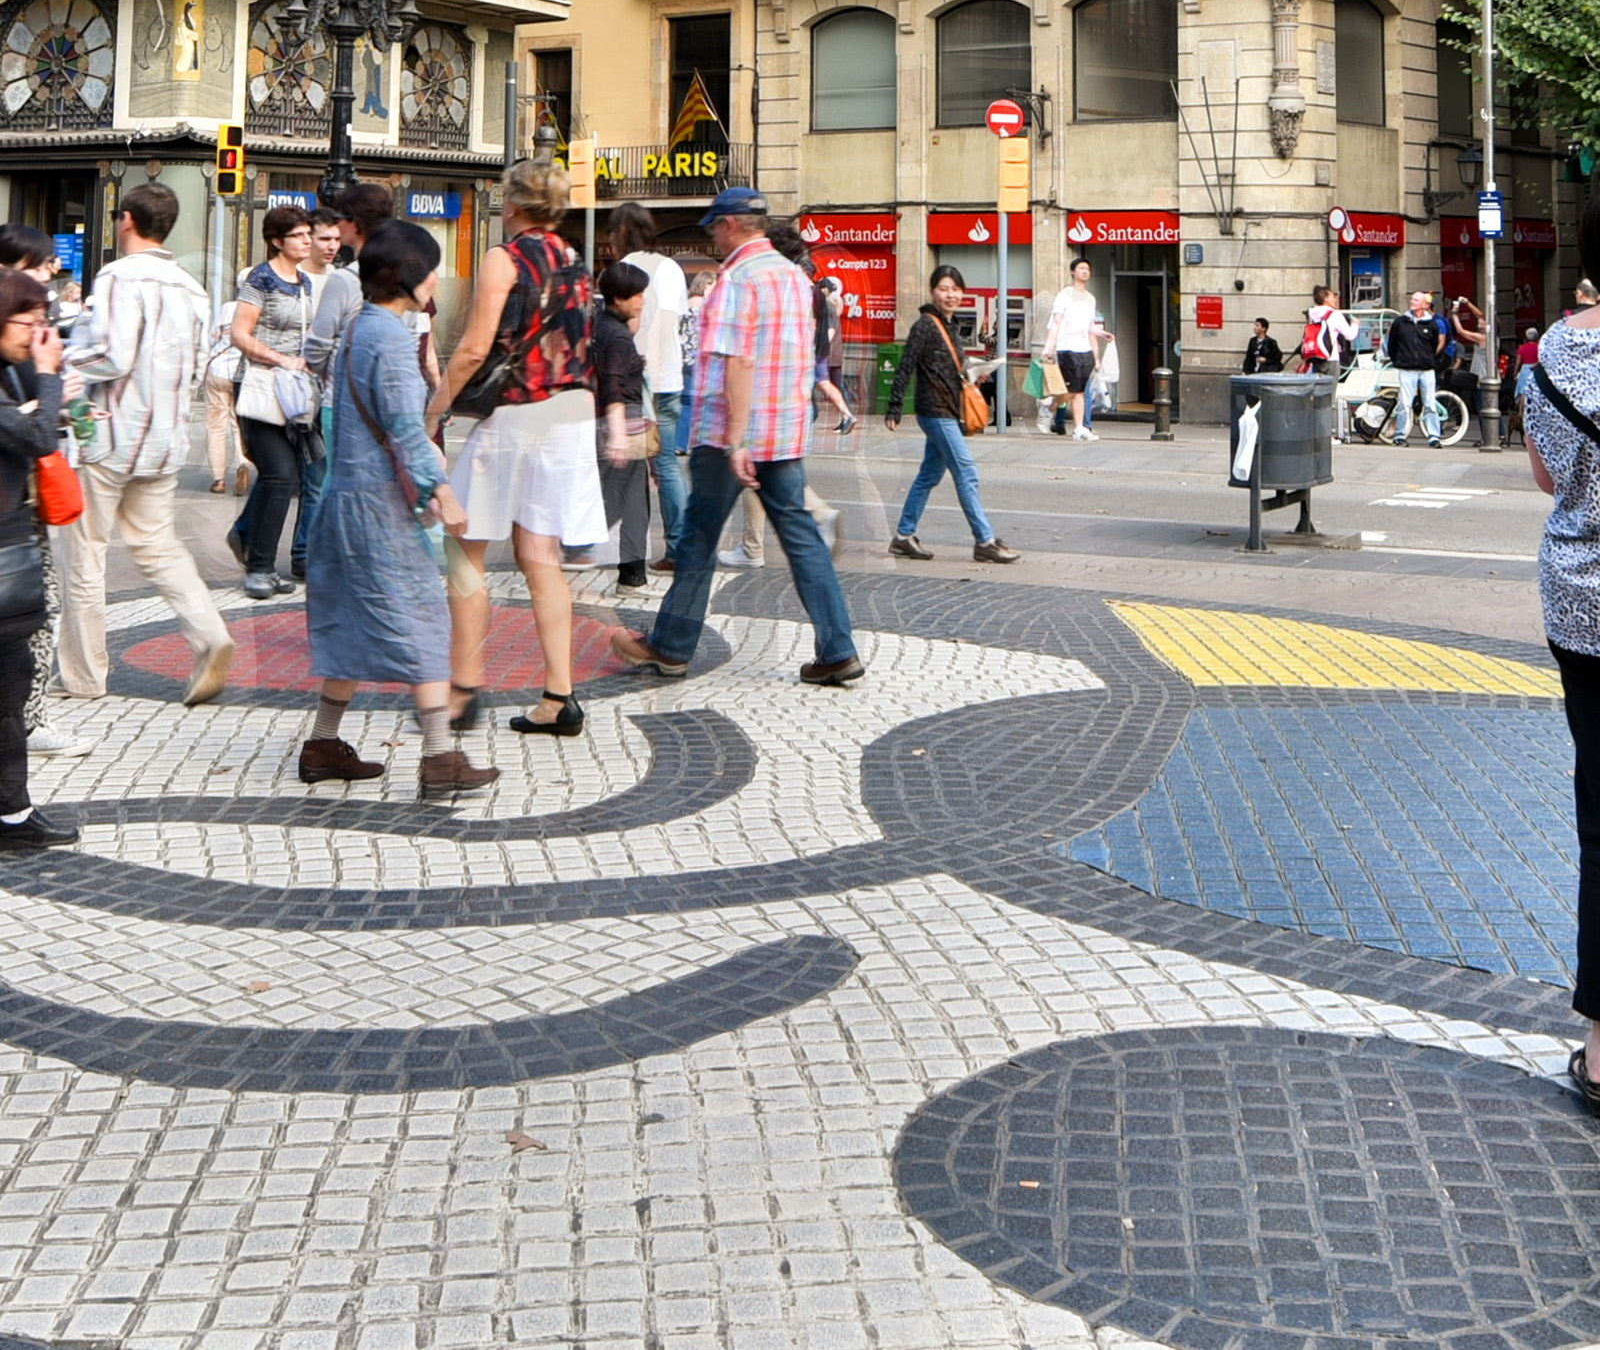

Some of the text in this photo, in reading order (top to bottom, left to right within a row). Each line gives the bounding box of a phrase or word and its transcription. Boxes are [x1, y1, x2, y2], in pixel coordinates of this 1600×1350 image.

[643, 150, 718, 179] PARIS
[411, 194, 445, 215] BBVA
[824, 223, 896, 242] Santander
[1096, 221, 1181, 242] Santander
[1356, 224, 1398, 244] Santander
[1522, 225, 1555, 243] Santander
[837, 258, 888, 271] Compte 123
